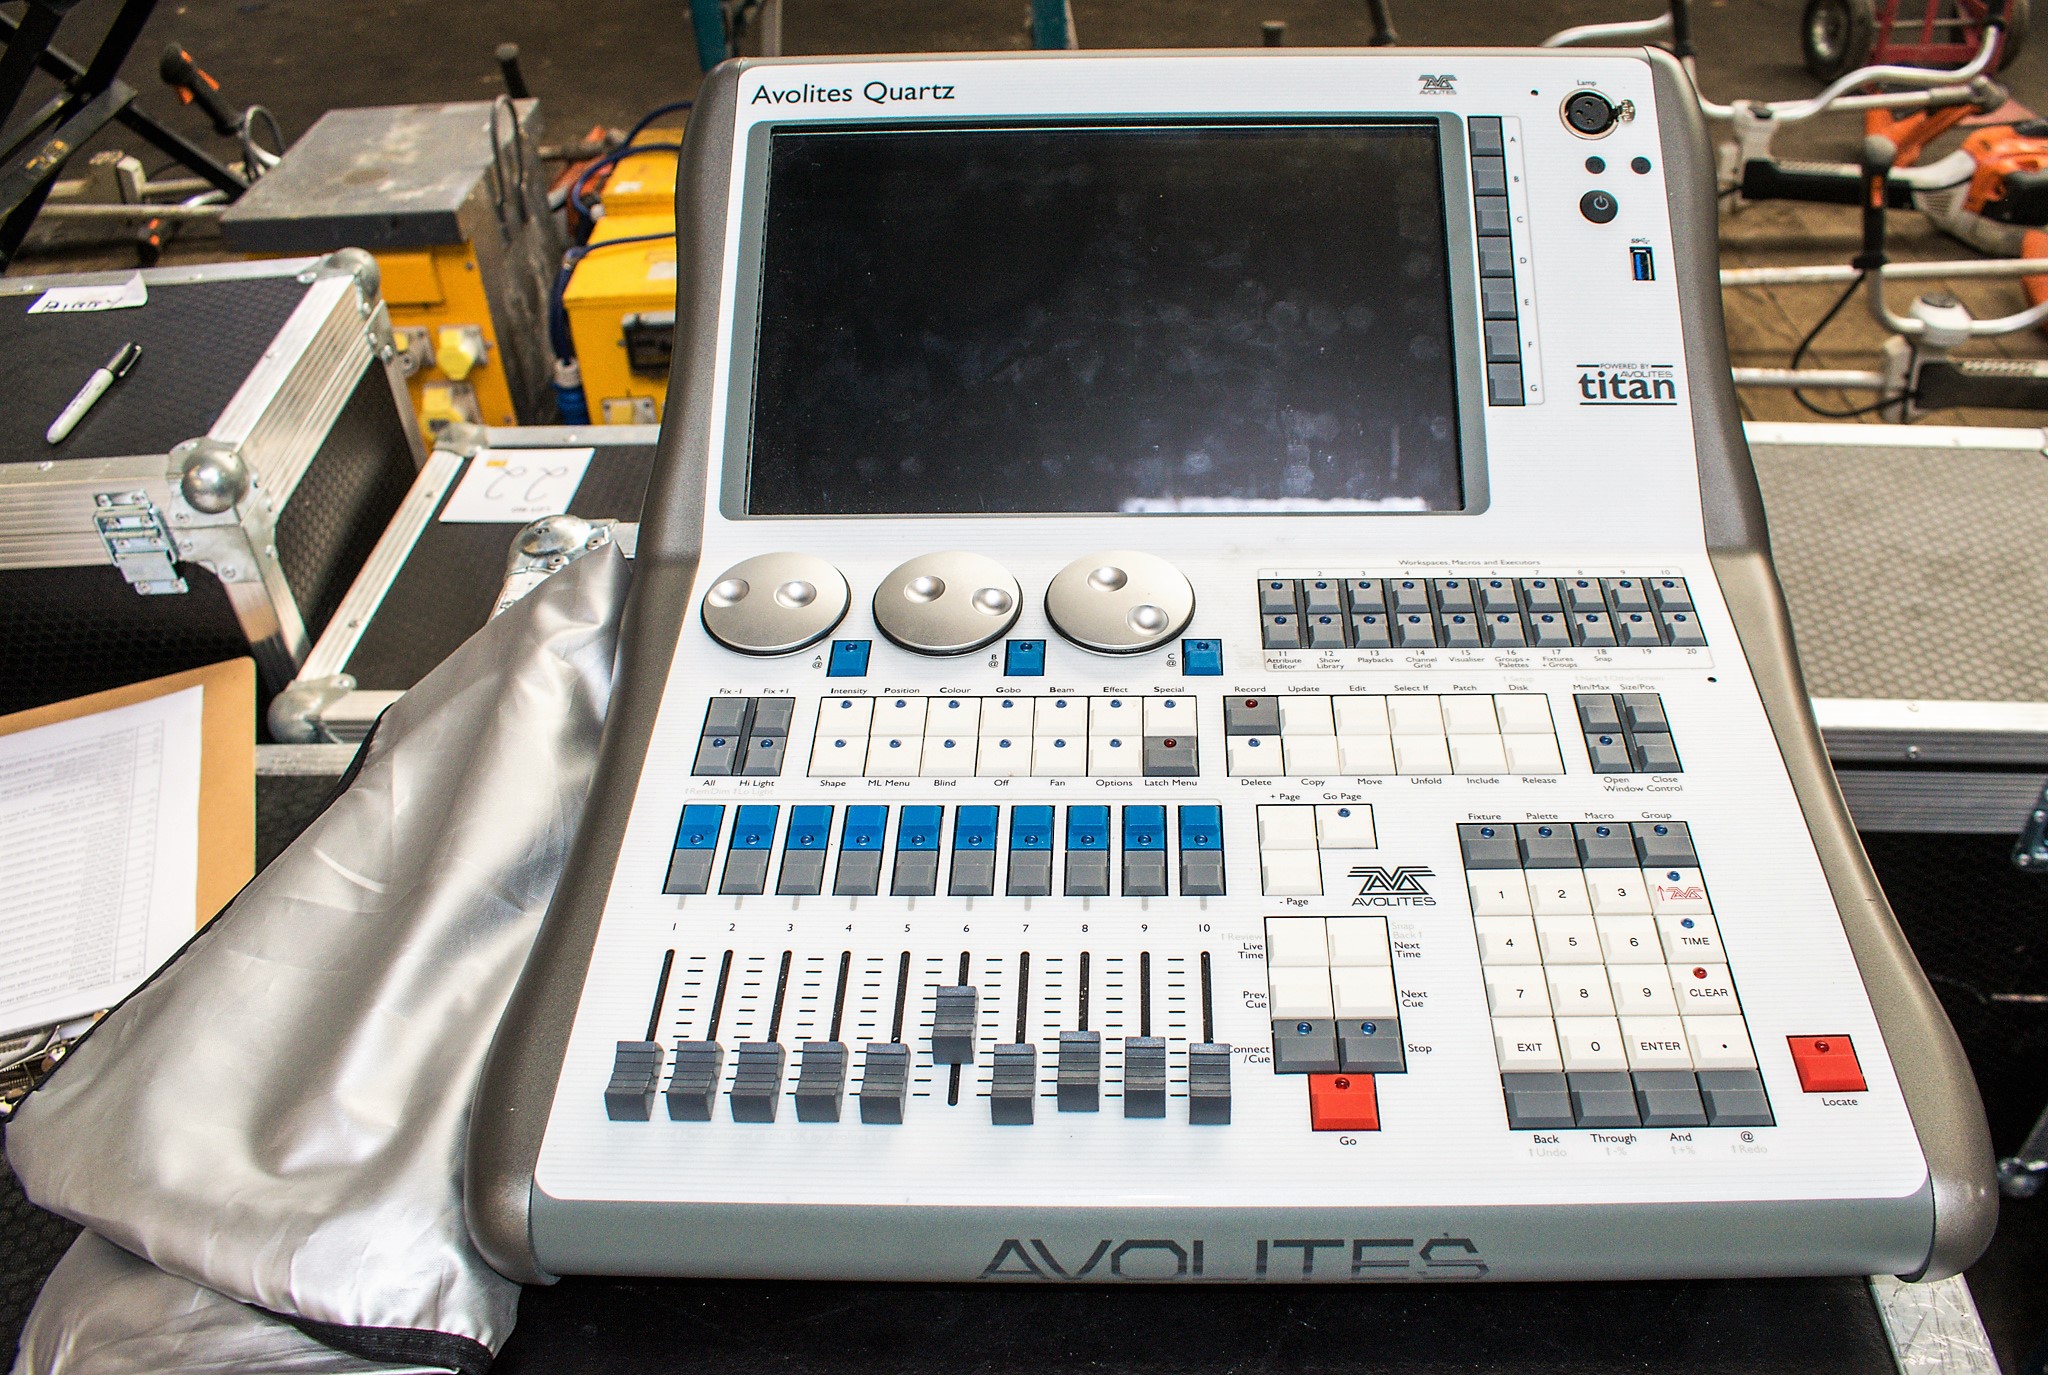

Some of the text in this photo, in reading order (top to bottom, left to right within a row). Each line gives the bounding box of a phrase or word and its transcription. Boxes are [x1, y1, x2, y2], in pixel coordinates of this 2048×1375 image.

[1576, 79, 1597, 87] Lamp
[752, 82, 954, 104] Avolites Quartz
[1513, 175, 1520, 183] B
[1516, 215, 1524, 224] C
[1519, 256, 1528, 265] D
[1524, 298, 1530, 306] E
[1530, 384, 1538, 392] G
[1578, 371, 1677, 400] titan
[814, 655, 822, 663] A
[990, 653, 998, 661] B
[1167, 652, 1175, 660] C
[811, 660, 823, 670] @
[987, 660, 999, 669] @
[1165, 659, 1177, 668] @
[719, 687, 732, 695] Fix
[830, 687, 868, 696] Intensity
[939, 686, 972, 694] Colour
[995, 686, 1022, 694] Gobo
[1153, 686, 1185, 694] Special
[1234, 685, 1267, 693] Record
[1287, 685, 1320, 693] Update
[1348, 684, 1367, 692] Edit
[1393, 684, 1429, 692] Select If
[702, 779, 716, 787] All
[867, 779, 910, 787] ML Menu
[933, 779, 957, 787] Blind
[993, 779, 1010, 787] Off
[1049, 778, 1066, 787] Fan
[1095, 778, 1133, 788] Options
[1144, 779, 1198, 787] Latch Menu
[1240, 778, 1272, 786] Delete
[1300, 778, 1326, 787] Copy
[1410, 777, 1443, 785] Unfold
[1466, 777, 1500, 785] Include
[1521, 776, 1557, 784] Release
[1603, 776, 1630, 785] Open
[1651, 775, 1679, 783] Close
[739, 779, 775, 789] Hi Light
[819, 779, 847, 789] Shape
[1603, 783, 1683, 792] Window Control
[1279, 792, 1301, 803] Page
[1322, 792, 1362, 802] Go Page
[1467, 812, 1502, 821] Fixture
[1525, 812, 1559, 820] Palette
[1584, 812, 1615, 820] Macro
[1640, 811, 1673, 820] Group
[1498, 890, 1505, 899] 1
[1557, 889, 1567, 899] 2
[1617, 887, 1627, 897] 3
[1286, 897, 1309, 908] Page
[1351, 896, 1437, 907] AVOLITES
[672, 922, 677, 931] 1
[728, 922, 736, 932] 2
[786, 923, 794, 932] 3
[845, 923, 852, 932] 4
[904, 923, 911, 933] 5
[963, 924, 970, 933] 6
[1022, 924, 1030, 933] 7
[1081, 923, 1089, 933] 8
[1141, 923, 1148, 933] 9
[1198, 923, 1211, 933] 10
[1393, 941, 1420, 950] Next
[1505, 938, 1514, 948] 4
[1568, 936, 1578, 947] 5
[1629, 937, 1639, 947] 6
[1680, 937, 1710, 946] TIME
[1243, 942, 1263, 951] Live
[1237, 950, 1264, 960] Time
[1394, 950, 1421, 959] Time
[1242, 990, 1268, 1002] Prev.
[1400, 989, 1428, 999] Next
[1516, 988, 1525, 999] 7
[1579, 988, 1589, 999] 8
[1642, 987, 1652, 998] 9
[1689, 988, 1729, 998] CLEAR
[1245, 999, 1267, 1009] Cue
[1402, 998, 1424, 1008] Cue
[1407, 1043, 1433, 1055] Stop
[1516, 1042, 1543, 1052] EXIT
[1590, 1041, 1601, 1052] 0
[1640, 1041, 1681, 1051] ENTER
[1244, 1054, 1270, 1063] /Cue
[1821, 1097, 1859, 1107] Locate
[1339, 1135, 1357, 1146] Go
[1533, 1134, 1560, 1144] Back
[1589, 1133, 1637, 1146] Through
[1669, 1132, 1693, 1142] And
[1740, 1130, 1755, 1143] @
[976, 1238, 1489, 1281] AVOLITES
